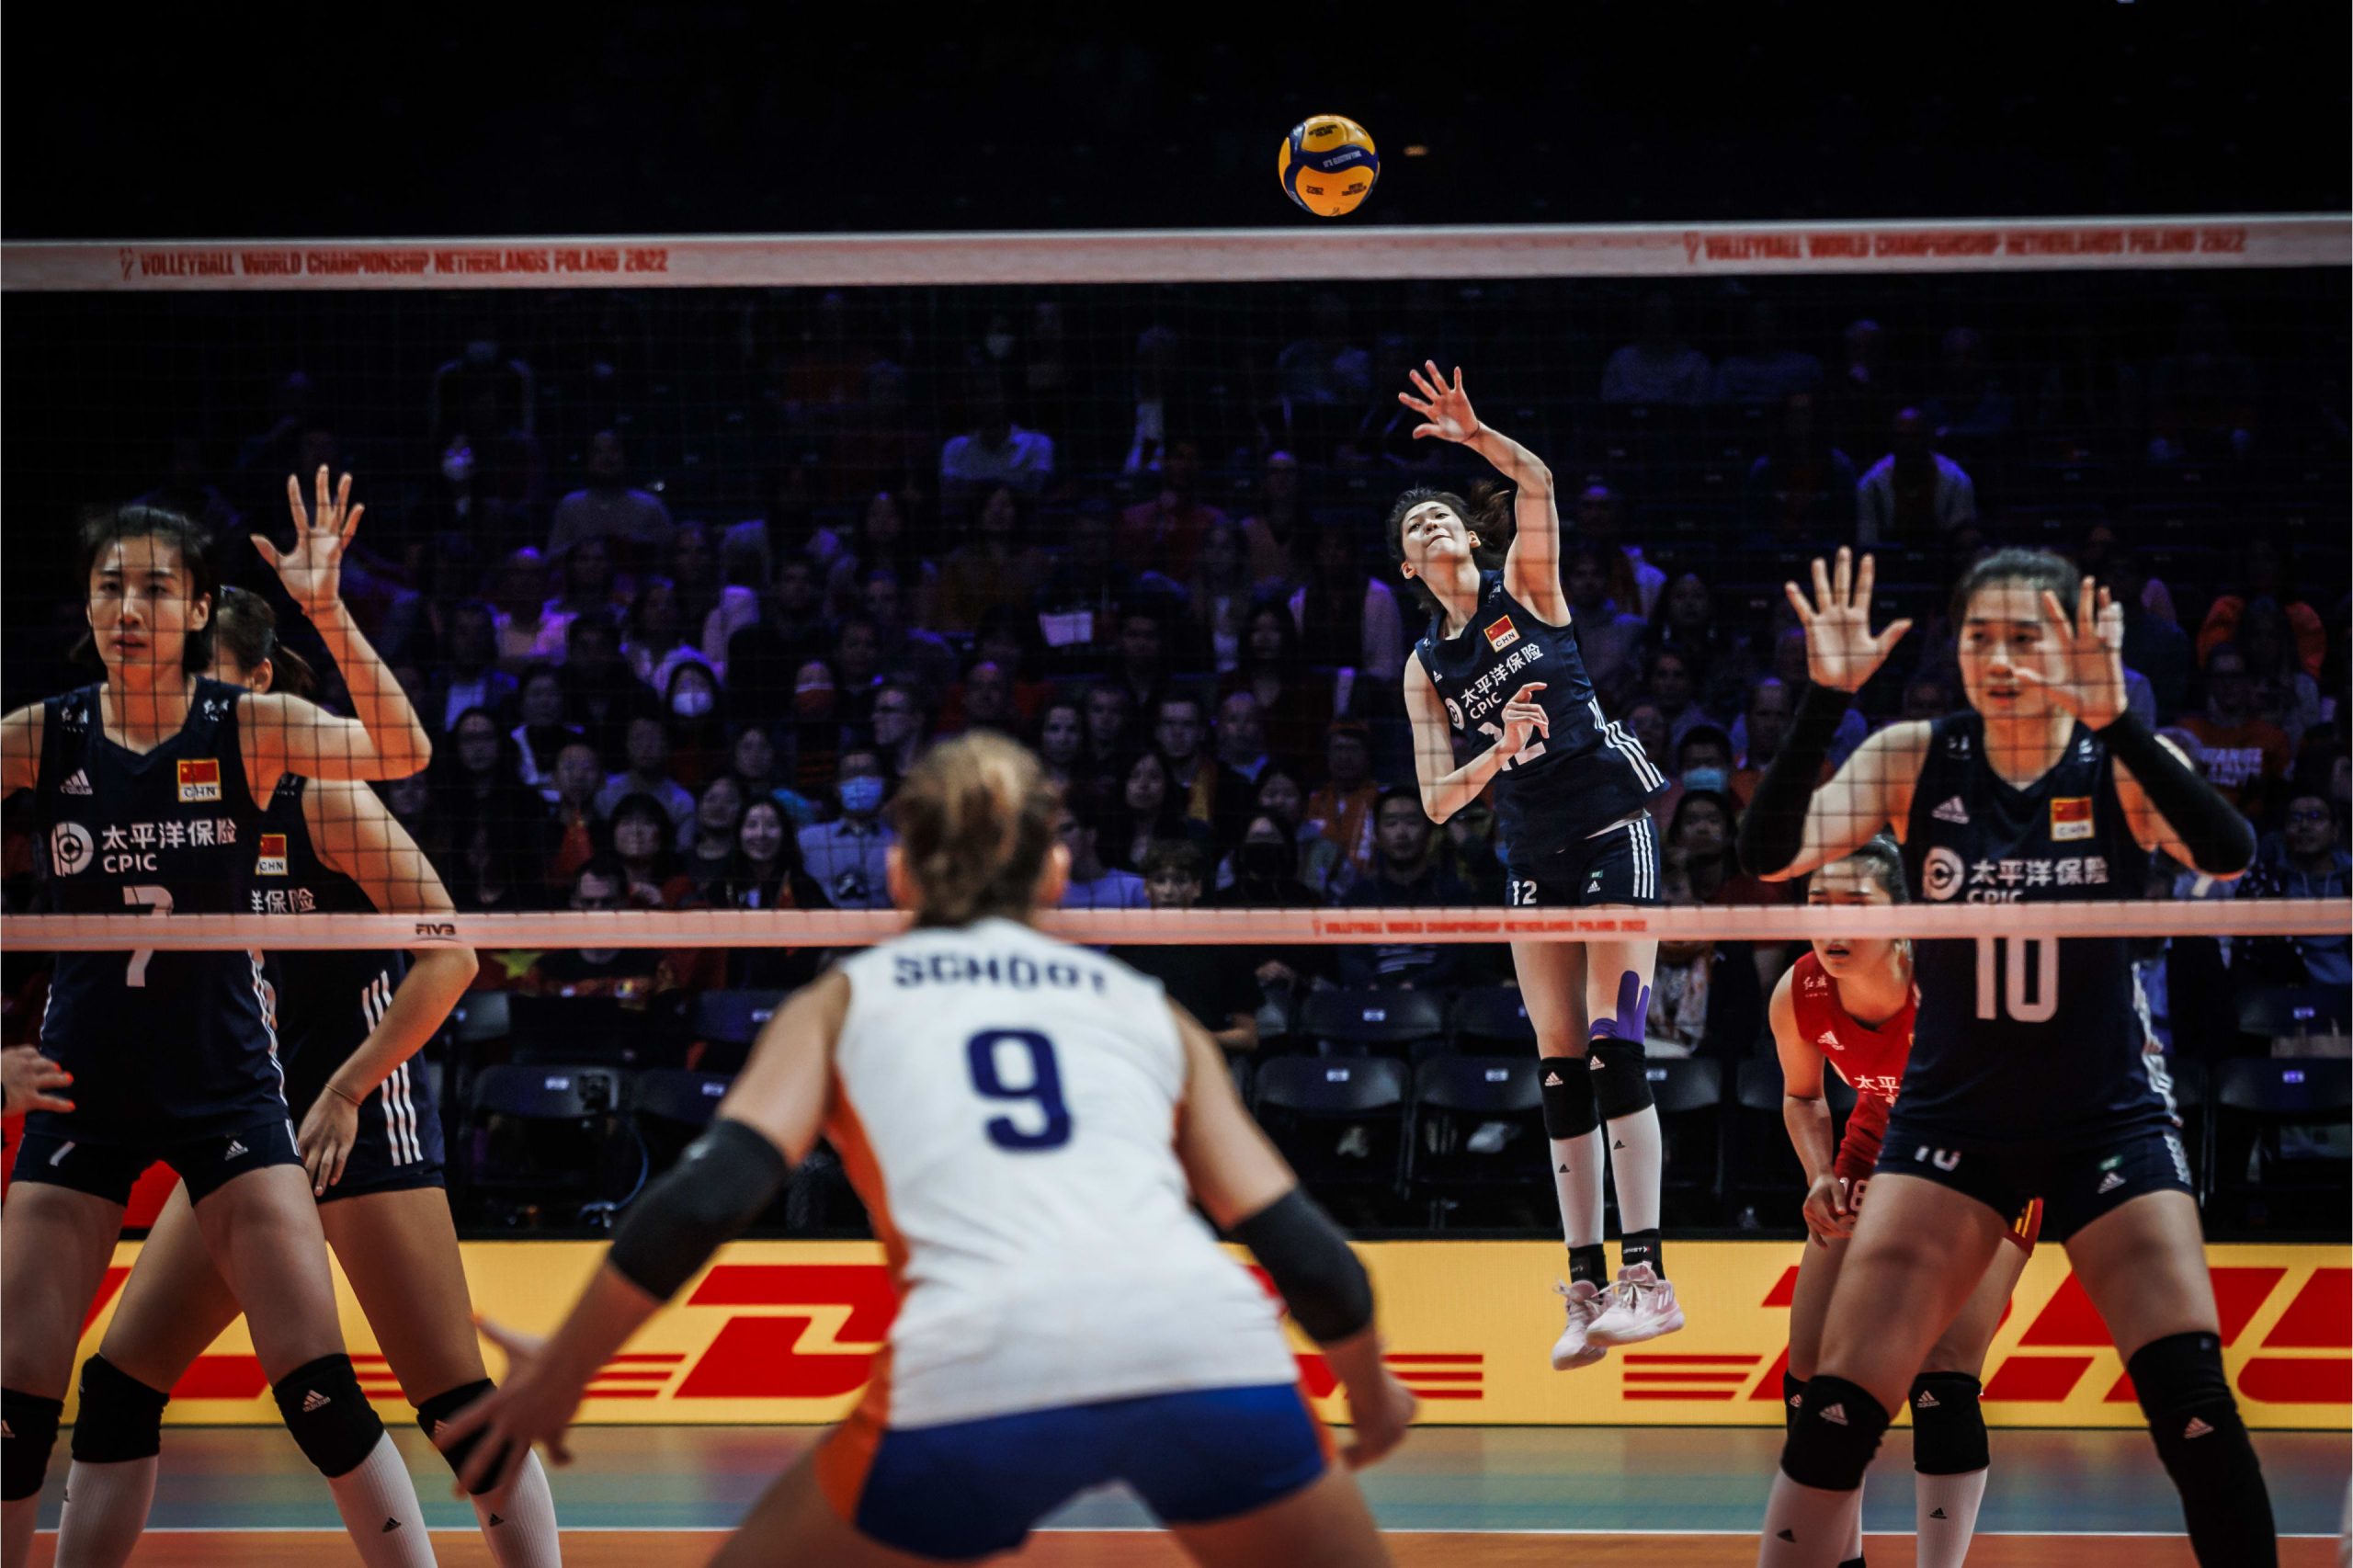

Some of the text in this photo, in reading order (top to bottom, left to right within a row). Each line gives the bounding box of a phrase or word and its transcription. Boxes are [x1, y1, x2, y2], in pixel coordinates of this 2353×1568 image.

[1807, 233, 1870, 258] WORLD
[1873, 232, 2001, 257] CHAMPIONSHIP
[2004, 230, 2123, 256] NETHERLANDS
[2129, 229, 2196, 254] POLAND
[2200, 228, 2248, 254] 2022
[140, 248, 669, 276] VOLLEYBALL WORLD CHAMPIONSHIP NETHERLANDS POLAND 2022
[1496, 632, 1516, 647] CHN
[1461, 642, 1544, 709] 太平洋保险
[1470, 691, 1503, 720] CPIC
[184, 785, 218, 799] CHN
[102, 818, 237, 851] 太平洋保险
[103, 853, 158, 873] CPIC
[259, 860, 284, 872] CHN
[1969, 856, 2109, 887] 太平洋保险
[1512, 880, 1538, 906] 12
[122, 885, 175, 987] 7
[415, 923, 456, 936] FIVB
[1976, 937, 2060, 1023] 10
[967, 1028, 1074, 1153] 9
